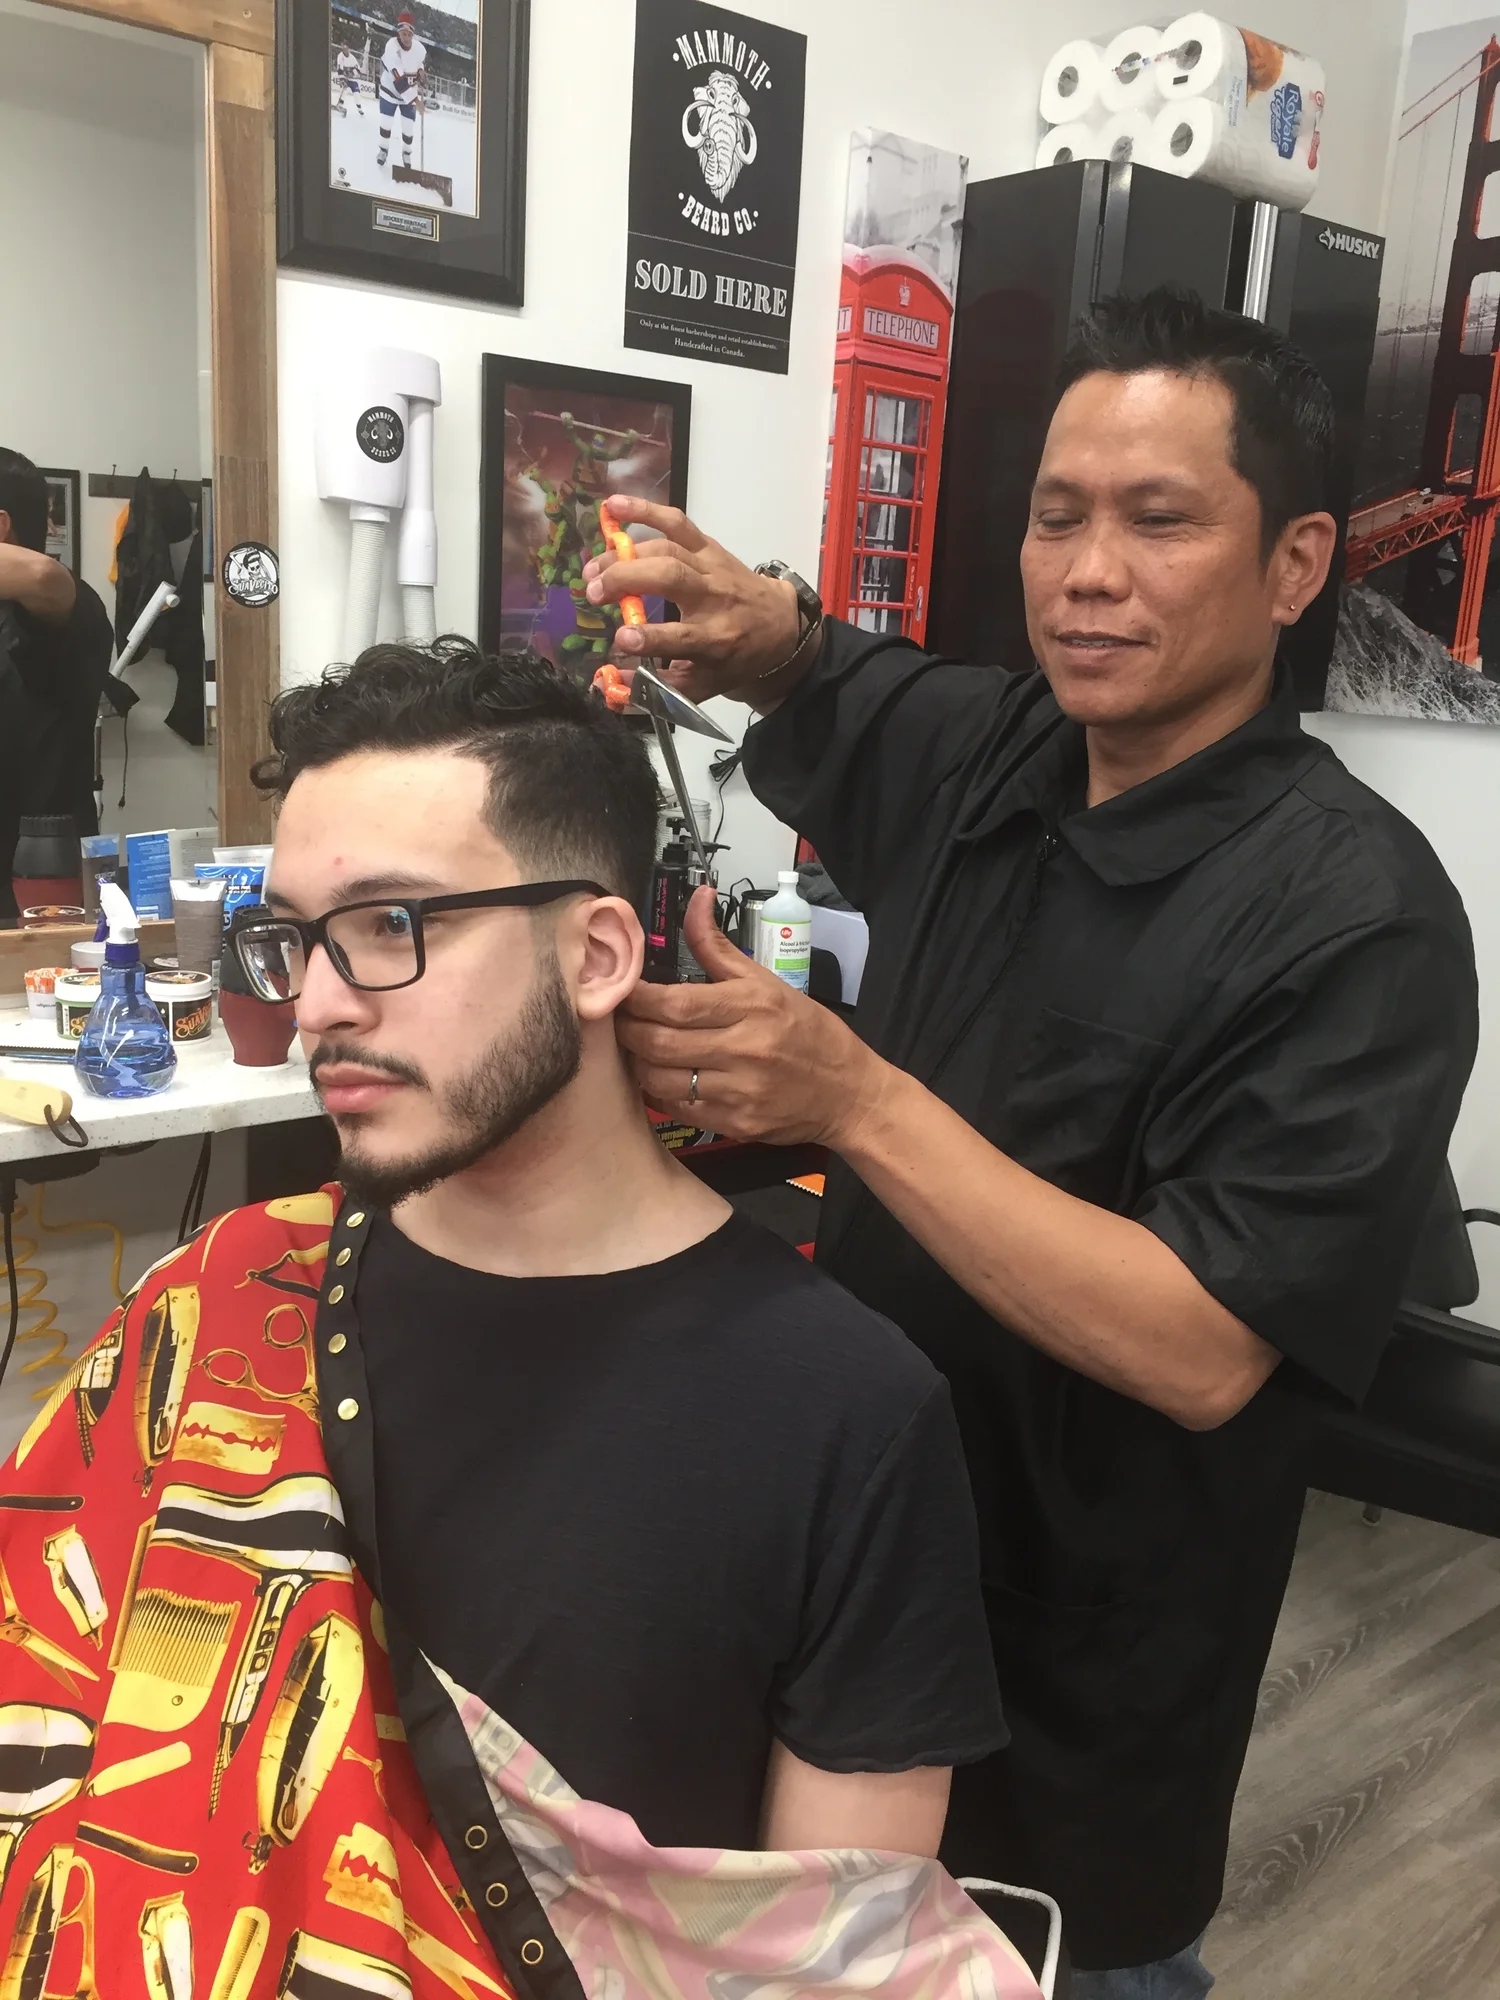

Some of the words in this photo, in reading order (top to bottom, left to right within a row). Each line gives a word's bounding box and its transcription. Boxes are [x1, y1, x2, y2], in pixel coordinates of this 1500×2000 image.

[676, 29, 770, 91] MAMMOTH
[1271, 86, 1286, 145] Tiger
[1280, 88, 1300, 153] Royale
[681, 194, 730, 236] BEARD
[733, 207, 757, 235] CO.
[1335, 232, 1380, 259] HUSKY
[635, 259, 707, 300] SOLD
[714, 275, 788, 317] HERE
[639, 318, 653, 331] Only
[660, 322, 669, 331] the
[670, 324, 685, 333] finest
[686, 327, 717, 340] barbershops
[718, 332, 727, 341] and
[728, 333, 741, 344] retail
[867, 309, 937, 345] TELEPHONE
[674, 337, 713, 352] Handcrafted
[714, 344, 720, 352] in
[721, 346, 746, 358] Canada.
[367, 411, 395, 424] MAMMOTH
[371, 446, 390, 458] BEARD
